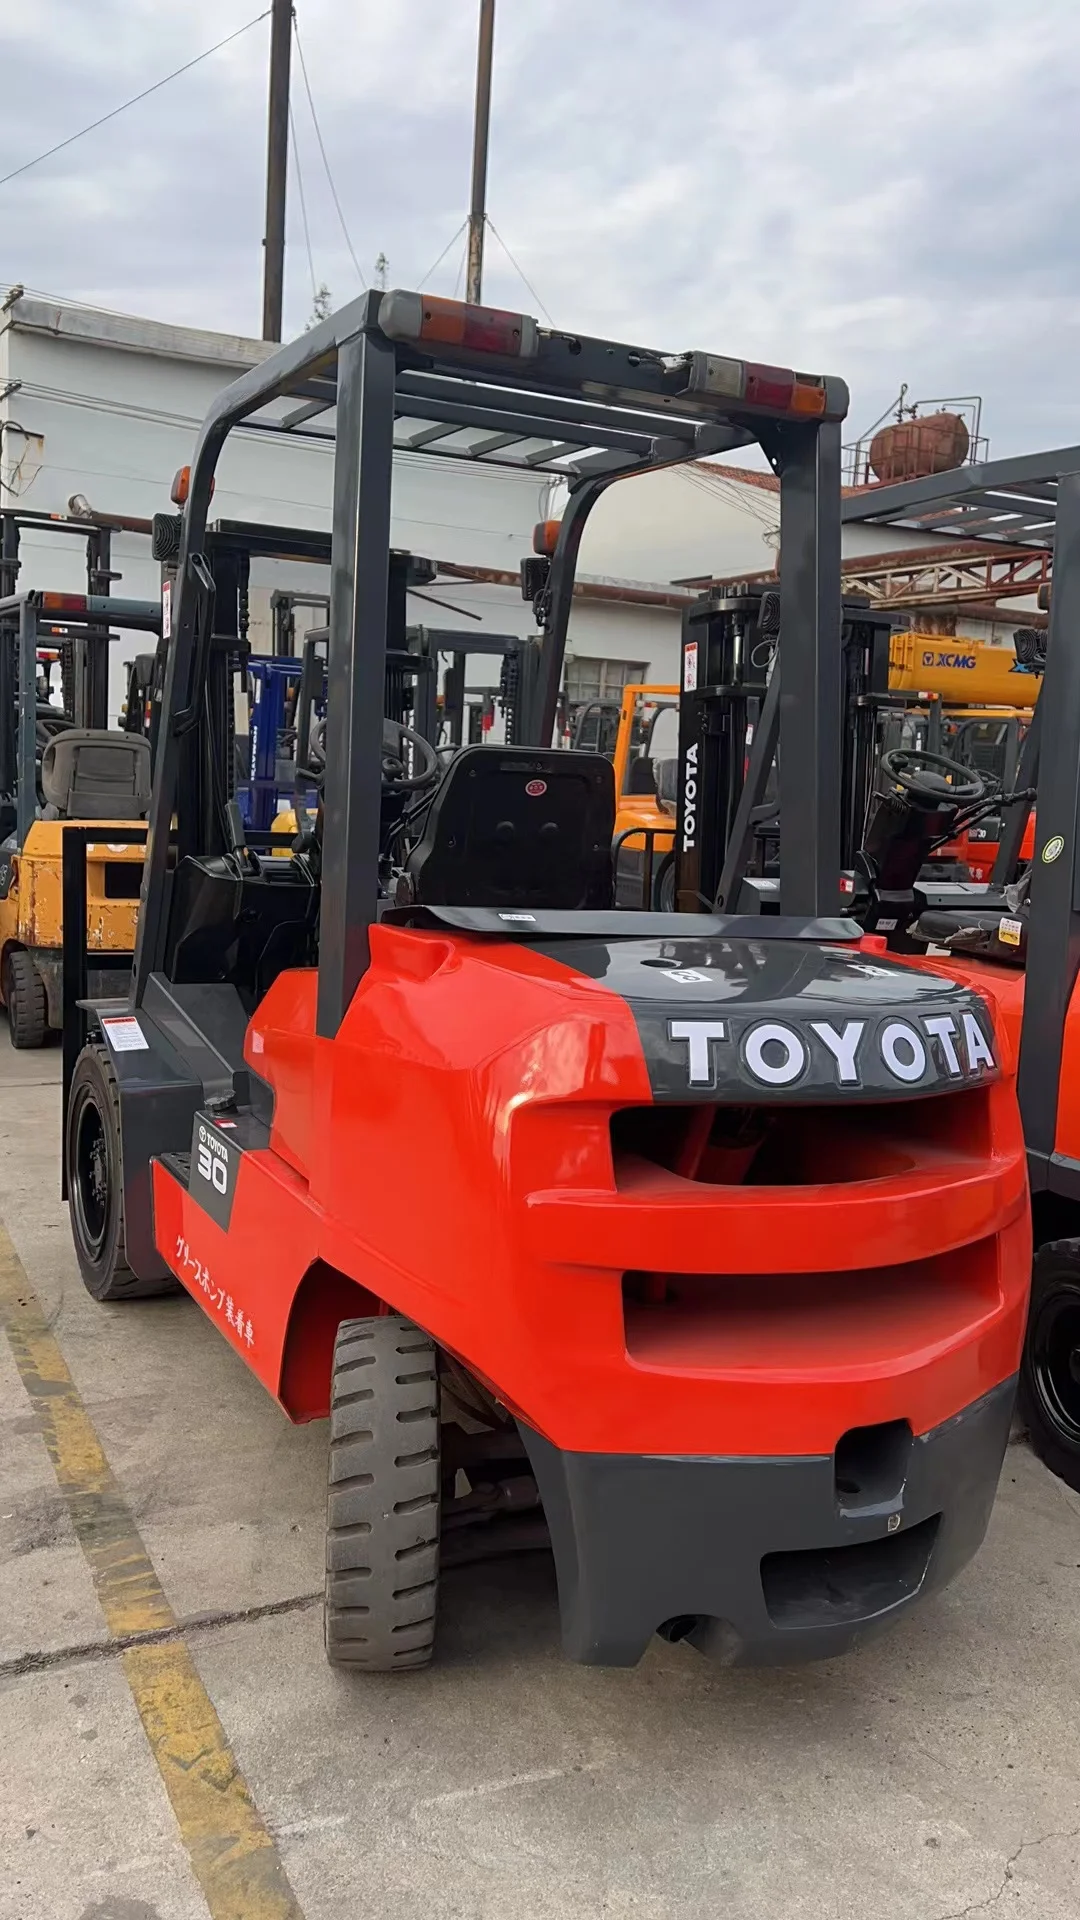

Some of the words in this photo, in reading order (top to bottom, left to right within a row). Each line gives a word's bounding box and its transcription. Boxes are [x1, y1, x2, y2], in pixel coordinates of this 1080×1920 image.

[935, 653, 977, 669] XCMG
[683, 742, 699, 853] TOYOTA
[671, 1013, 995, 1084] TOYOTA
[197, 1143, 228, 1195] 30
[207, 1132, 229, 1162] TOYOTA
